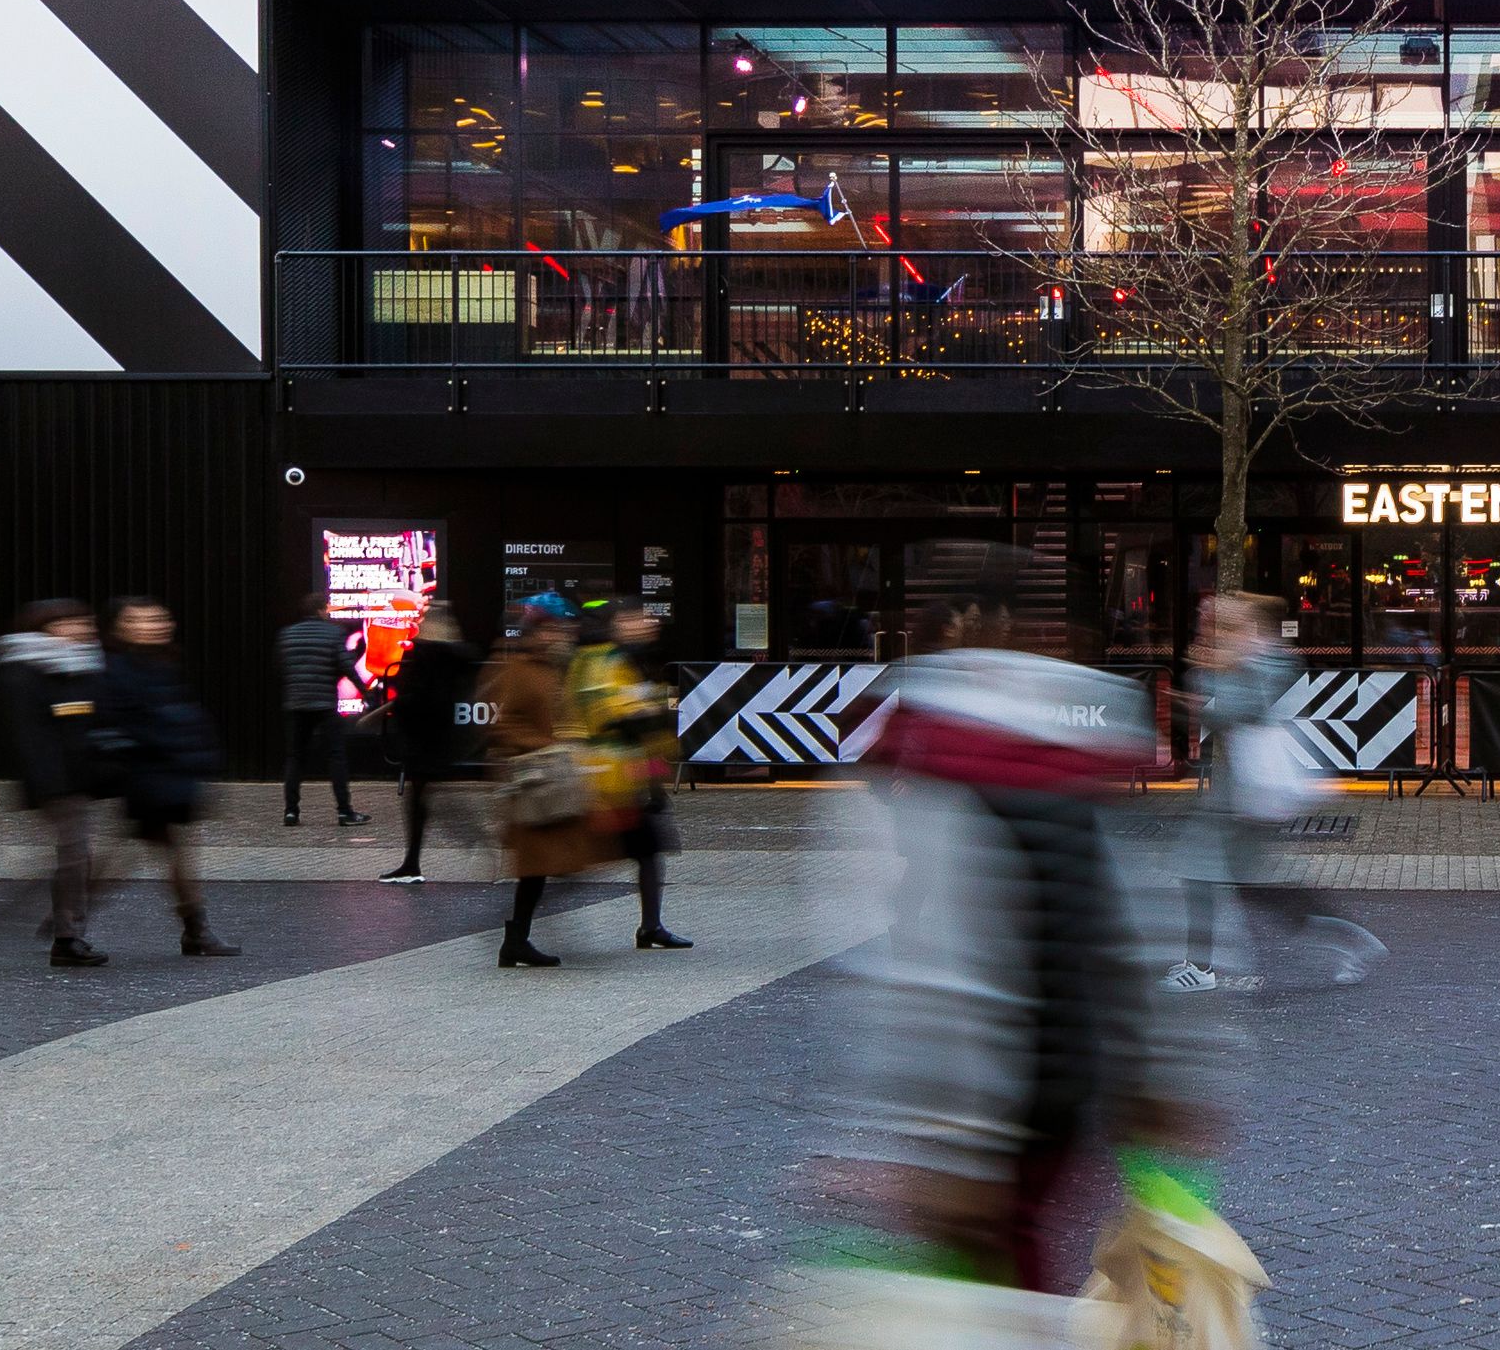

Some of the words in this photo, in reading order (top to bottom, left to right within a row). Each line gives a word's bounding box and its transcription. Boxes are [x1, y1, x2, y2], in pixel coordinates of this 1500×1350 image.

[1342, 482, 1450, 524] EAST
[505, 544, 565, 555] DIRECTORY
[505, 567, 528, 575] FIRST
